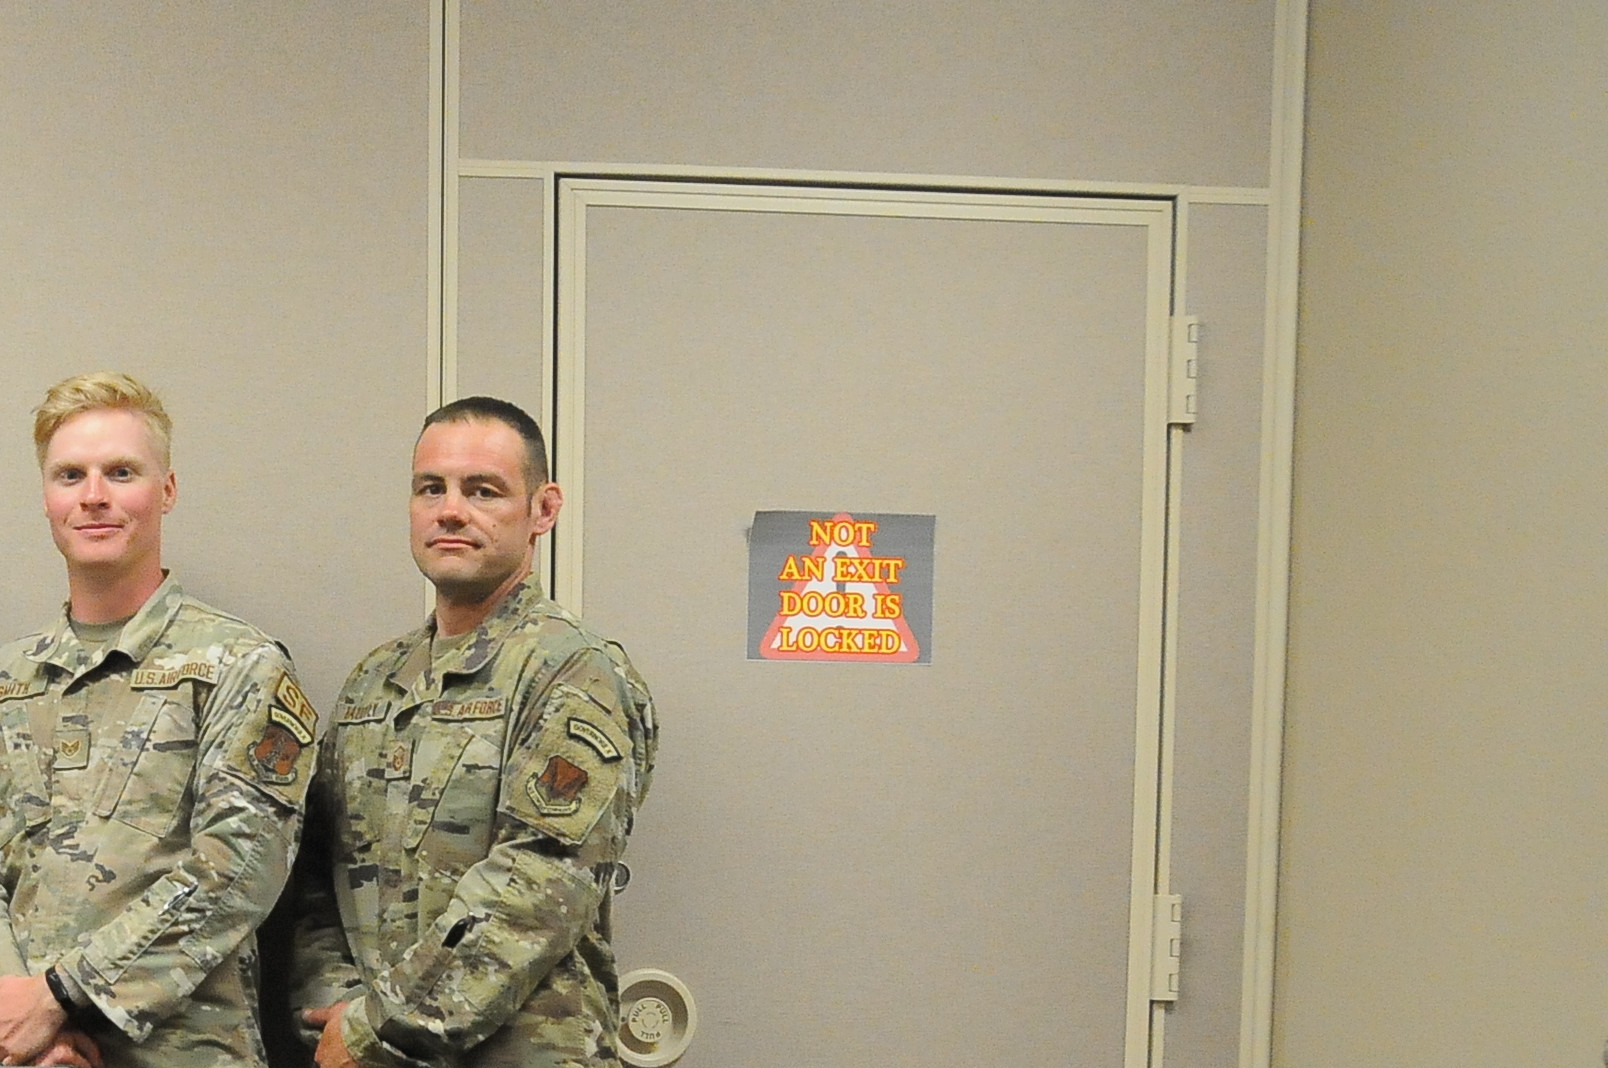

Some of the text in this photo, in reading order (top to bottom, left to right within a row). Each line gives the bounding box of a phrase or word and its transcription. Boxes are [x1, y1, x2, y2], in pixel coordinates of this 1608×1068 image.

[809, 520, 878, 547] NOT
[778, 556, 904, 583] AN EXIT
[779, 591, 902, 619] DOOR IS
[778, 626, 902, 653] LOCKED
[159, 670, 176, 686] AIR
[631, 1004, 646, 1023] PULL
[655, 1004, 669, 1024] PULL
[641, 1031, 661, 1039] PULL
